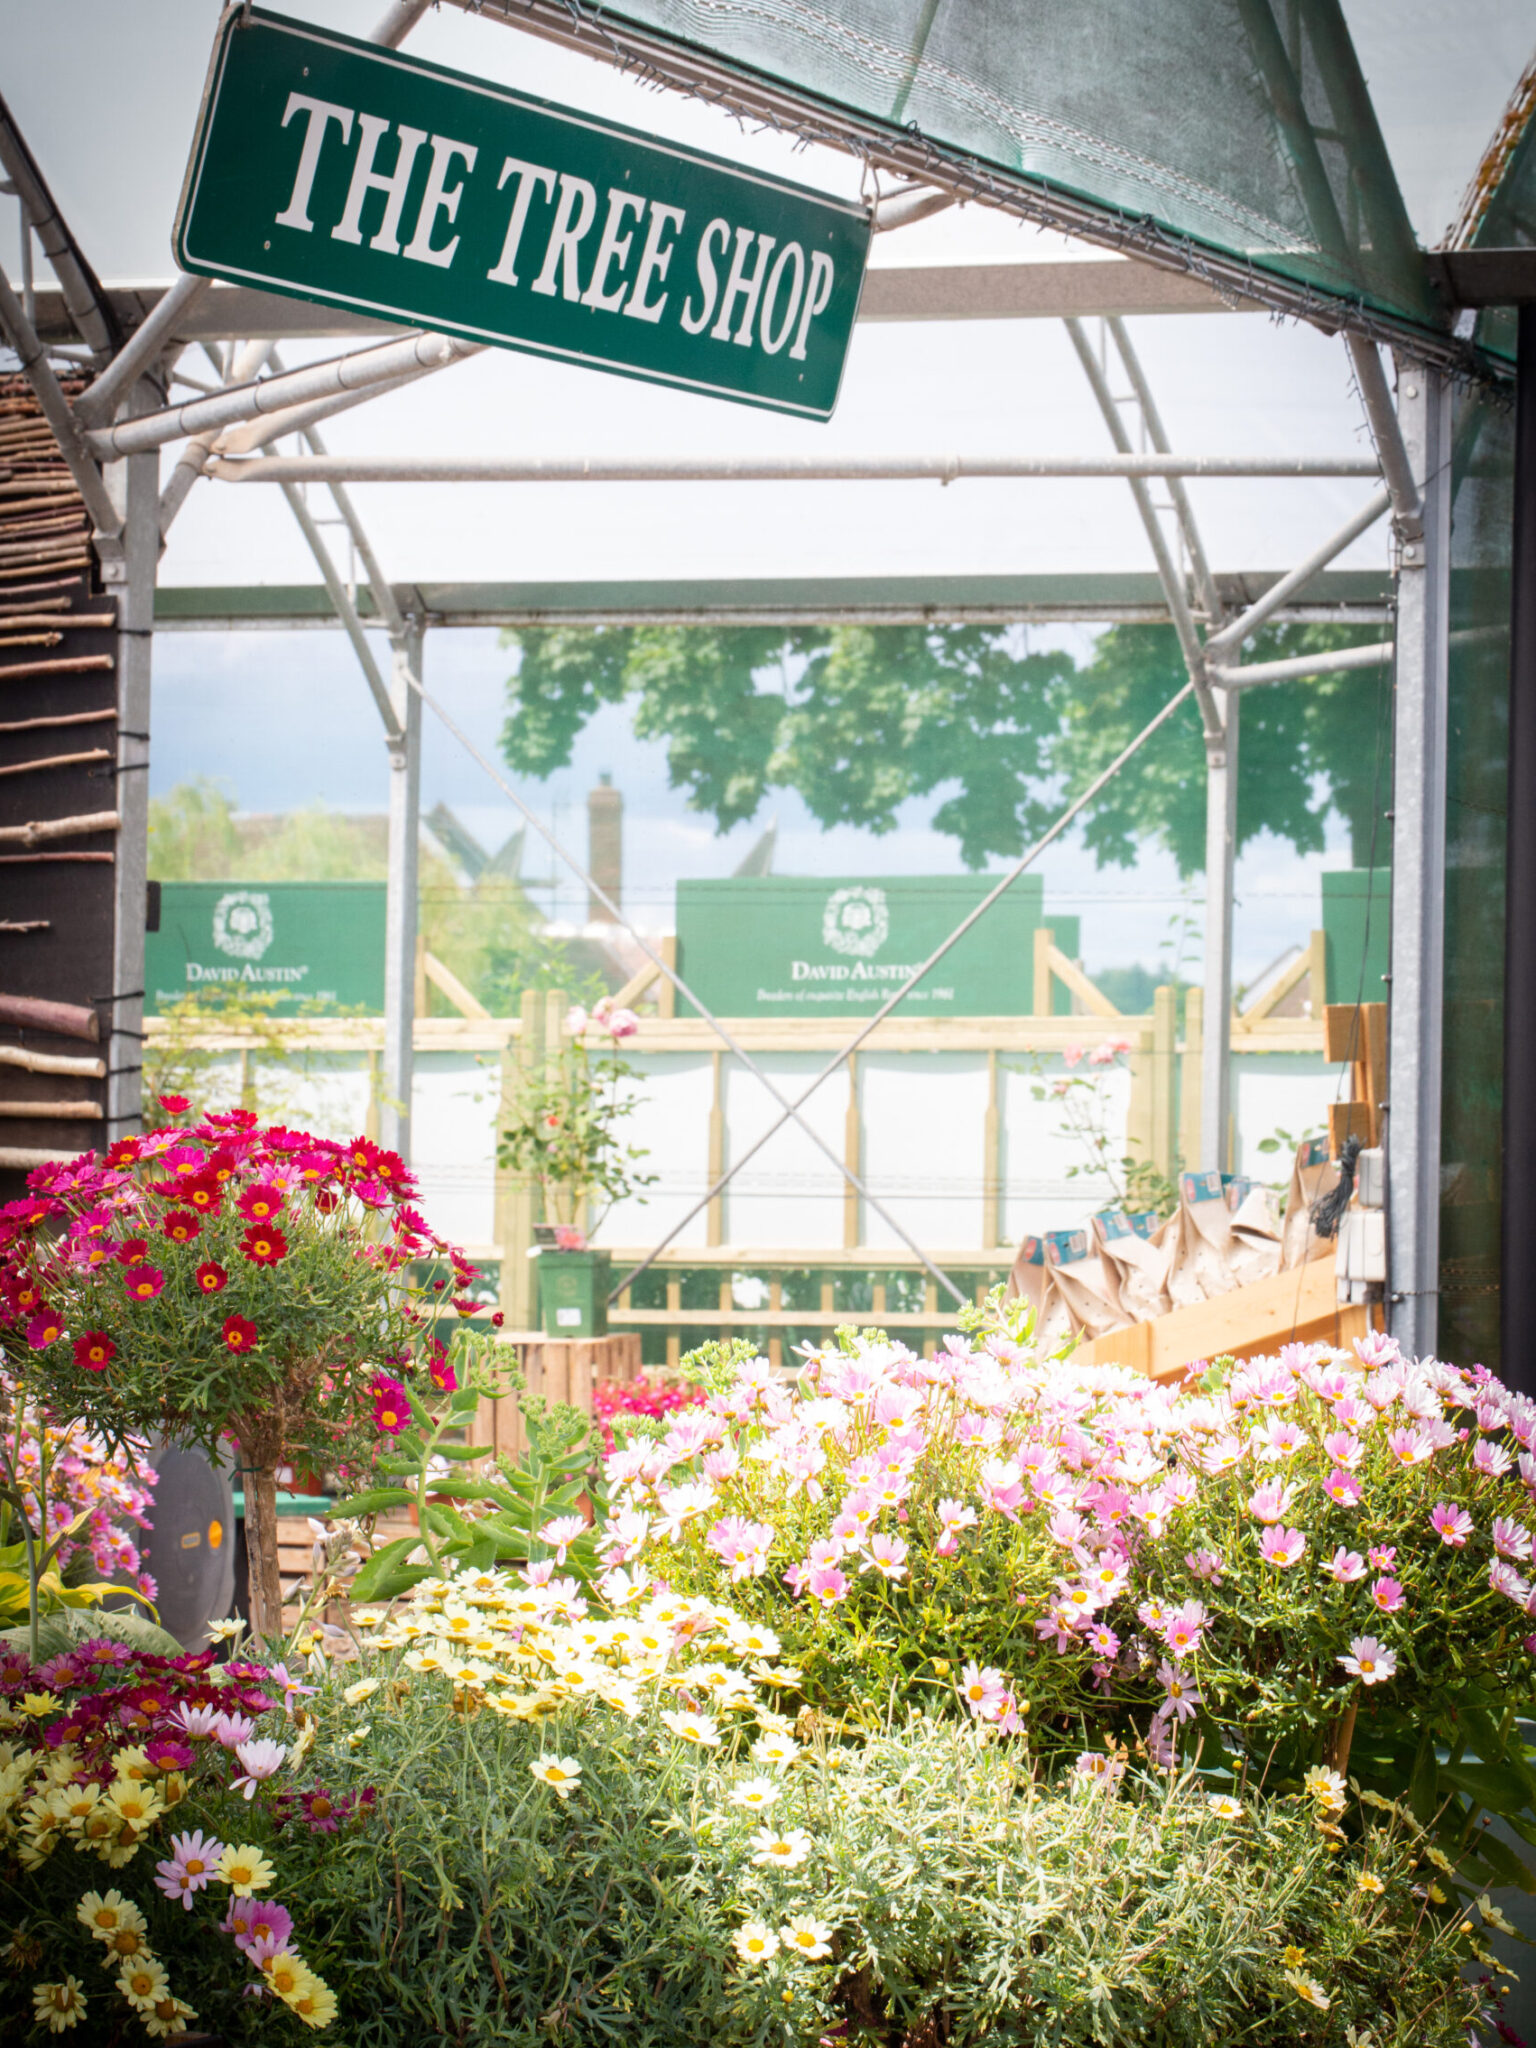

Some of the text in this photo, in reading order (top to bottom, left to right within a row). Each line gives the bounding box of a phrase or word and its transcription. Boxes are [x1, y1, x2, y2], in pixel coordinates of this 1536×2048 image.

[275, 92, 834, 360] THE TREE SHOP
